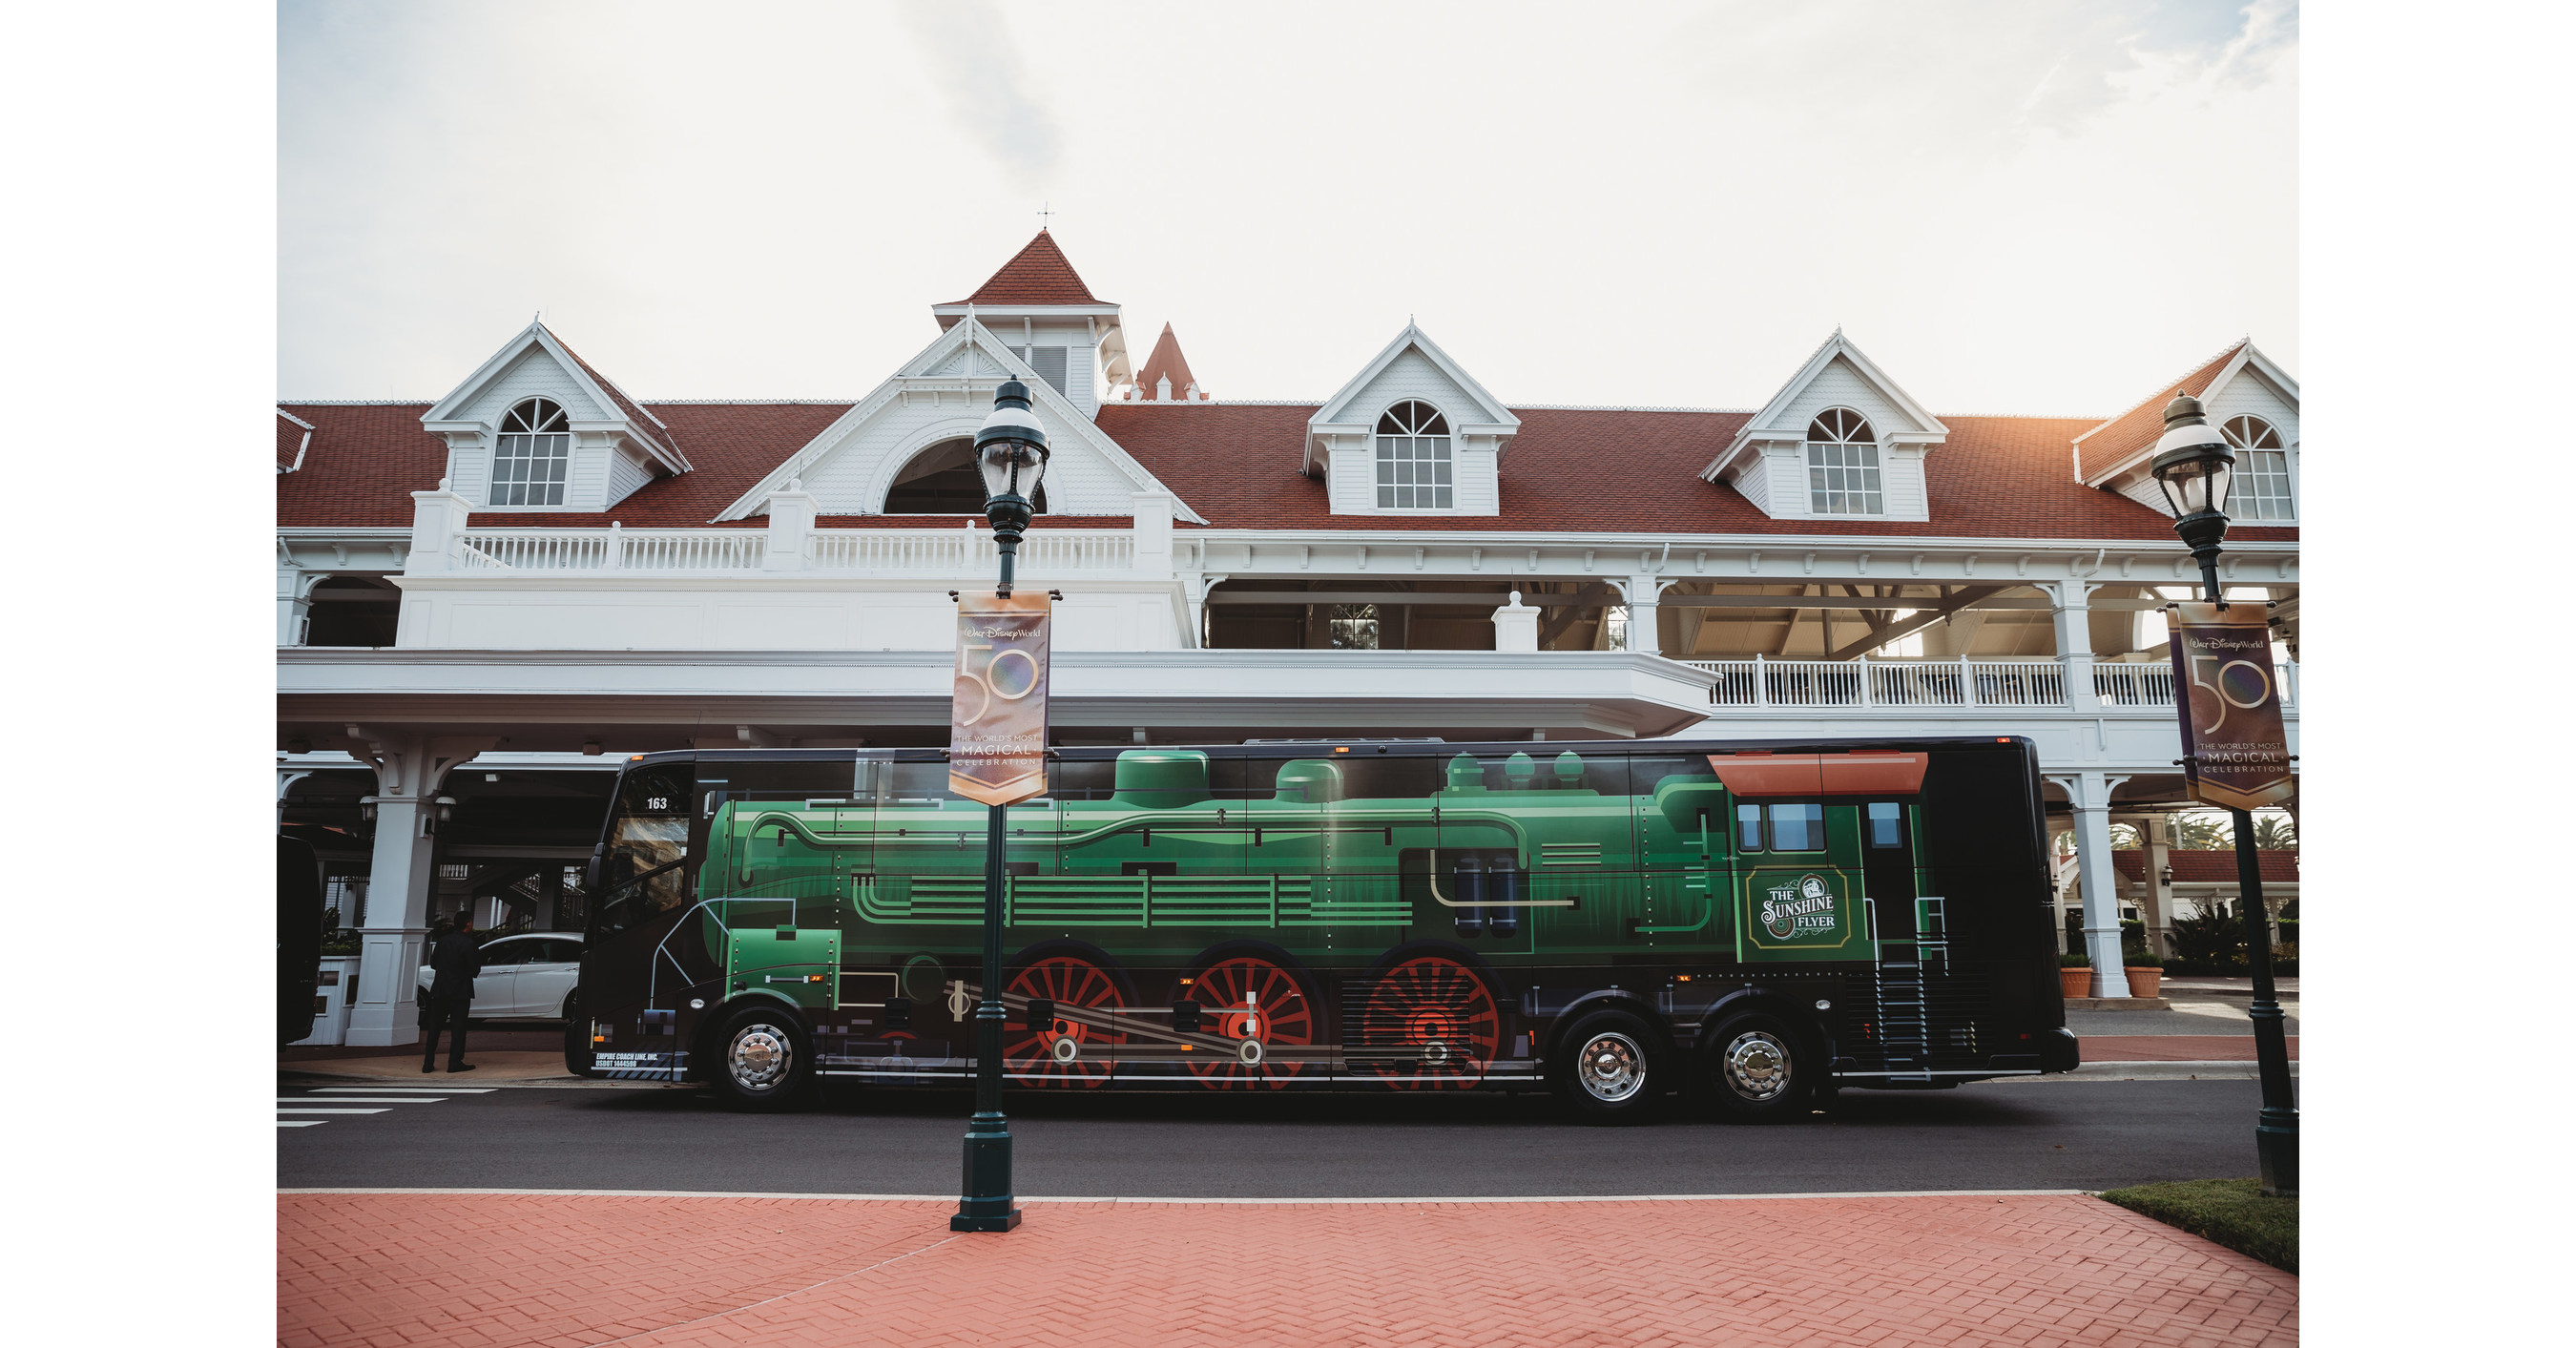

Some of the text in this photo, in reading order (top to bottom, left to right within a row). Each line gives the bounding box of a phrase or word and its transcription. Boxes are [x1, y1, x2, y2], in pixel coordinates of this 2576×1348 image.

[962, 644, 1039, 727] 50
[2191, 654, 2271, 735] 50
[961, 744, 1031, 756] MAGICAL
[956, 757, 1036, 766] CELEBRATION
[2208, 752, 2280, 763] MAGICAL
[2203, 765, 2284, 774] CELEBRATION
[647, 798, 667, 810] 163
[1769, 890, 1794, 901] THE
[1760, 896, 1834, 925] SUNSHINE
[1797, 917, 1835, 927] FLYER
